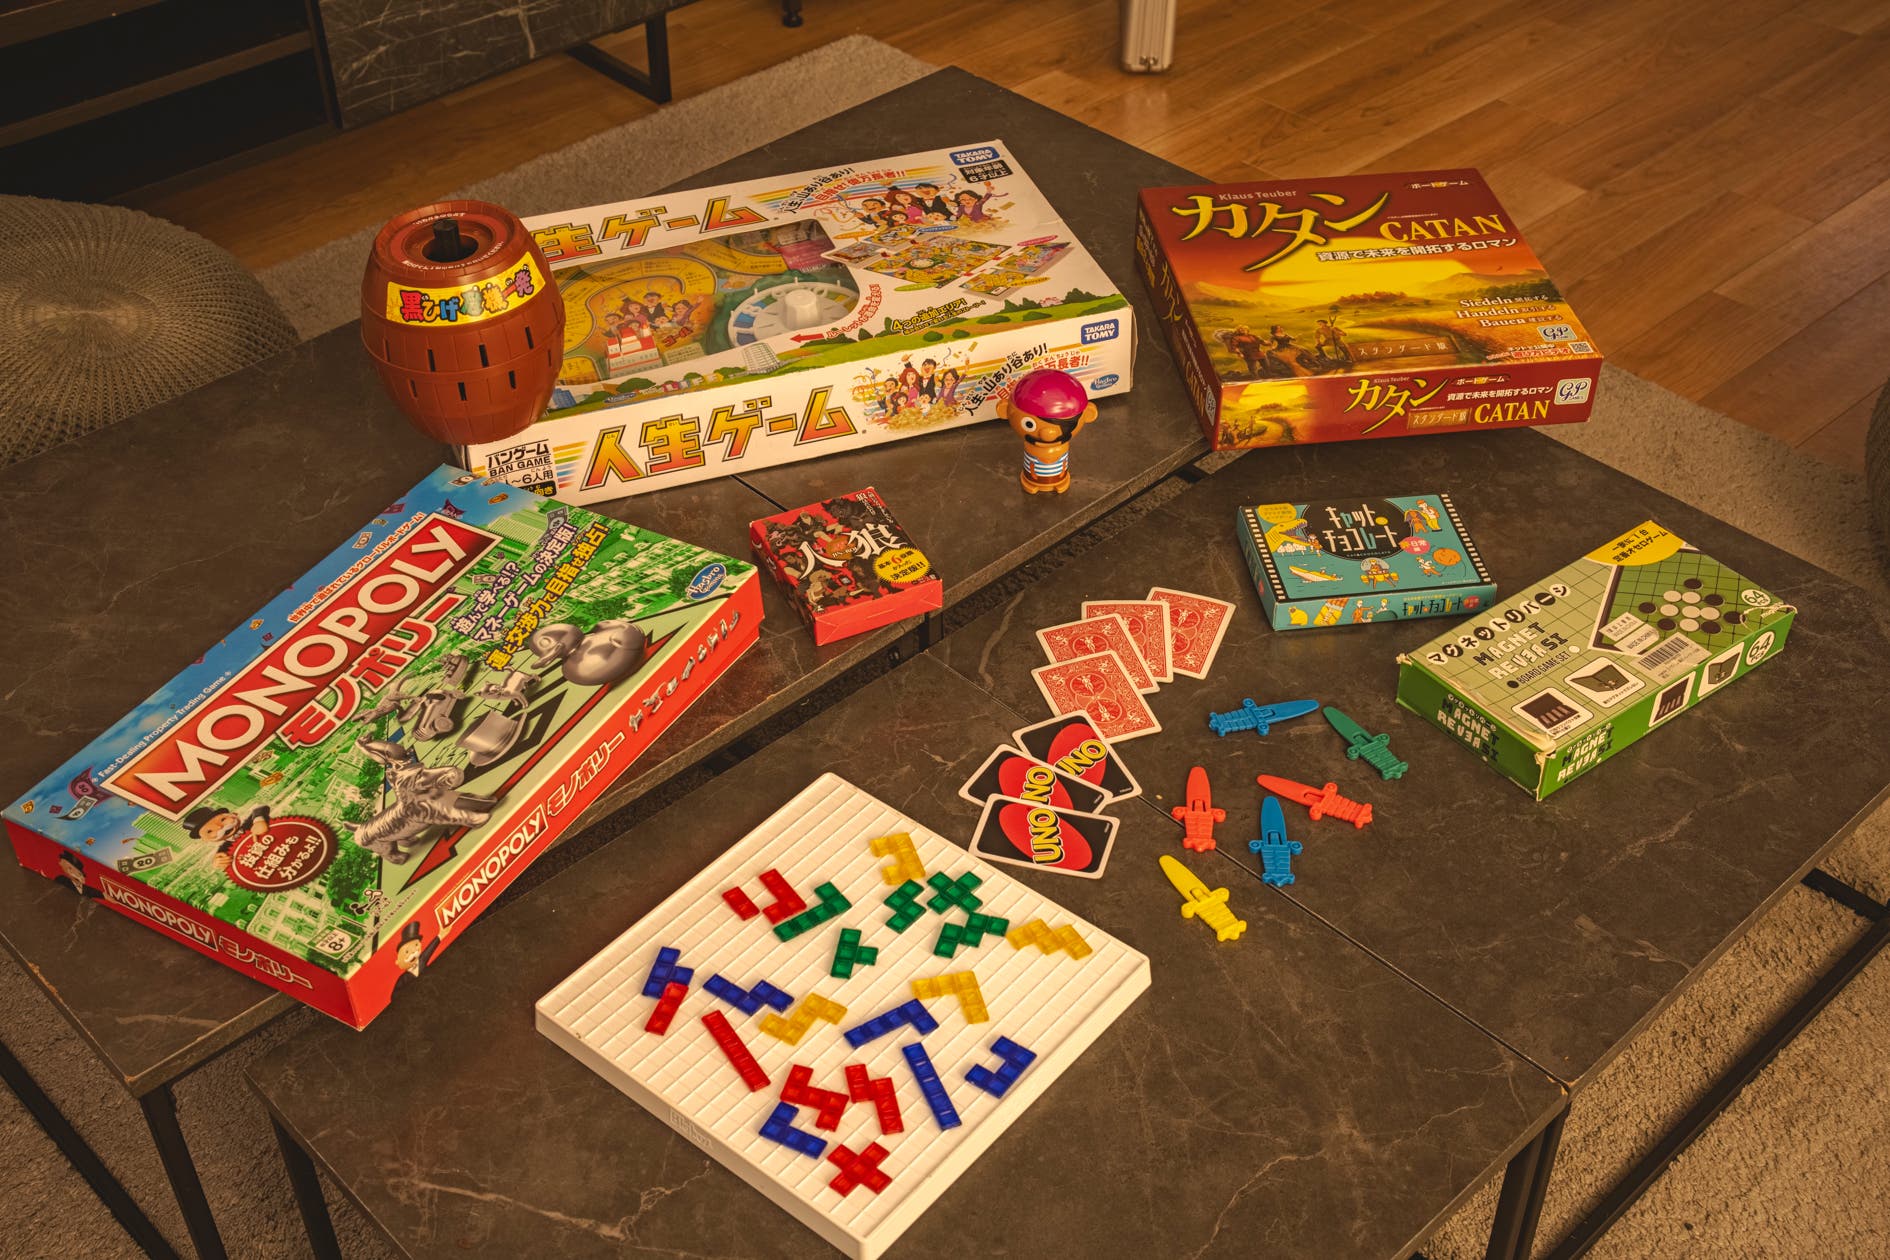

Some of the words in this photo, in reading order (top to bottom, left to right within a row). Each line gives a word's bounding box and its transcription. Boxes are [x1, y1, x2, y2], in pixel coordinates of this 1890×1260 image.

[1218, 191, 1254, 201] Klaus
[1254, 189, 1298, 200] Teuber
[531, 195, 770, 264] 生ゲーム
[1171, 191, 1390, 273] カタン
[1379, 213, 1507, 243] CATAN
[1317, 237, 1517, 262] 資源で未来を開拓するロマン
[1456, 306, 1520, 319] Handeln
[1459, 296, 1513, 309] Siedeln
[1479, 317, 1526, 328] Bauen
[1084, 322, 1116, 334] TAKARA
[1084, 329, 1116, 342] TOMY
[964, 342, 1048, 417] 人生、山あり谷あり!
[1447, 386, 1554, 402] 資源で未来を開拓するロマン
[1343, 377, 1450, 435] カタン
[1474, 400, 1551, 424] CATAN
[488, 442, 550, 469] バンゲーム
[579, 385, 858, 492] 人生ゲーム
[489, 463, 514, 478] BAN
[517, 455, 552, 469] GAME
[1324, 503, 1376, 529] キャット
[799, 522, 908, 580] 人狼
[1321, 525, 1398, 553] チョコレート
[451, 562, 521, 636] 遊んで学べる!?
[473, 521, 580, 642] マネーゲームの決定版!
[485, 521, 612, 672] 運と交渉力で目指せ独占!
[1744, 590, 1764, 604] 64
[1427, 584, 1570, 665] マグネットリバーシ
[1472, 621, 1546, 666] MAGNET
[1749, 634, 1772, 657] 64
[135, 526, 467, 803] MONOPOLY
[275, 594, 467, 751] モノポリー
[1487, 632, 1569, 680] REVERSI
[1516, 668, 1540, 685] BOARD
[1537, 658, 1557, 675] GAME
[1554, 650, 1572, 665] SET
[97, 739, 148, 779] Fast-Dealing
[143, 713, 179, 744] Property
[175, 692, 207, 717] Trading
[202, 674, 227, 696] Game
[1441, 697, 1500, 746] MAGNET
[1054, 739, 1108, 777] UNO
[1561, 725, 1615, 767] MAGNET
[1020, 765, 1056, 805] NO
[441, 811, 543, 926] MONOPOLY
[546, 731, 626, 818] モノポリー
[1027, 807, 1065, 865] UNO
[238, 834, 275, 868] 投資の
[254, 835, 300, 879] 仕組みも
[278, 835, 323, 880] 分かるよ!!
[108, 884, 212, 944] MONOPOLY
[218, 935, 314, 990] モノポリー
[327, 936, 347, 952] 8+
